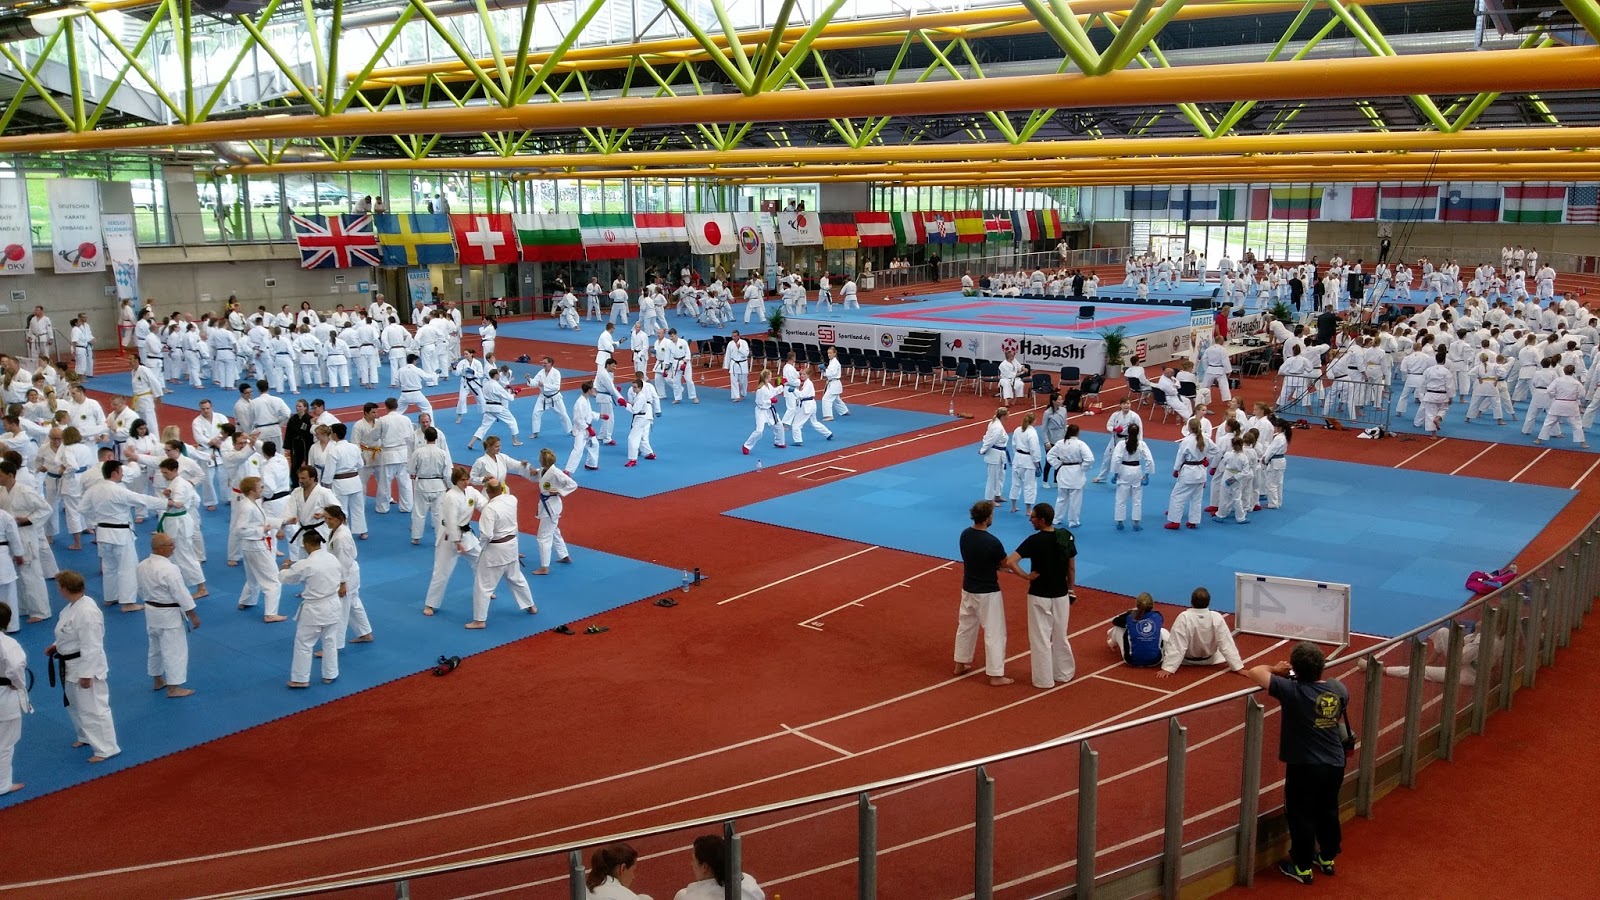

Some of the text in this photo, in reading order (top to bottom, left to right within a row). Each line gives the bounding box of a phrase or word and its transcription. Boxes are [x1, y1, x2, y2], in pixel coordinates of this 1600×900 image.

[1191, 316, 1212, 327] KARATE
[785, 329, 815, 337] Sportland.de
[838, 333, 871, 341] Sportland.de
[1020, 339, 1087, 360] Hayashi
